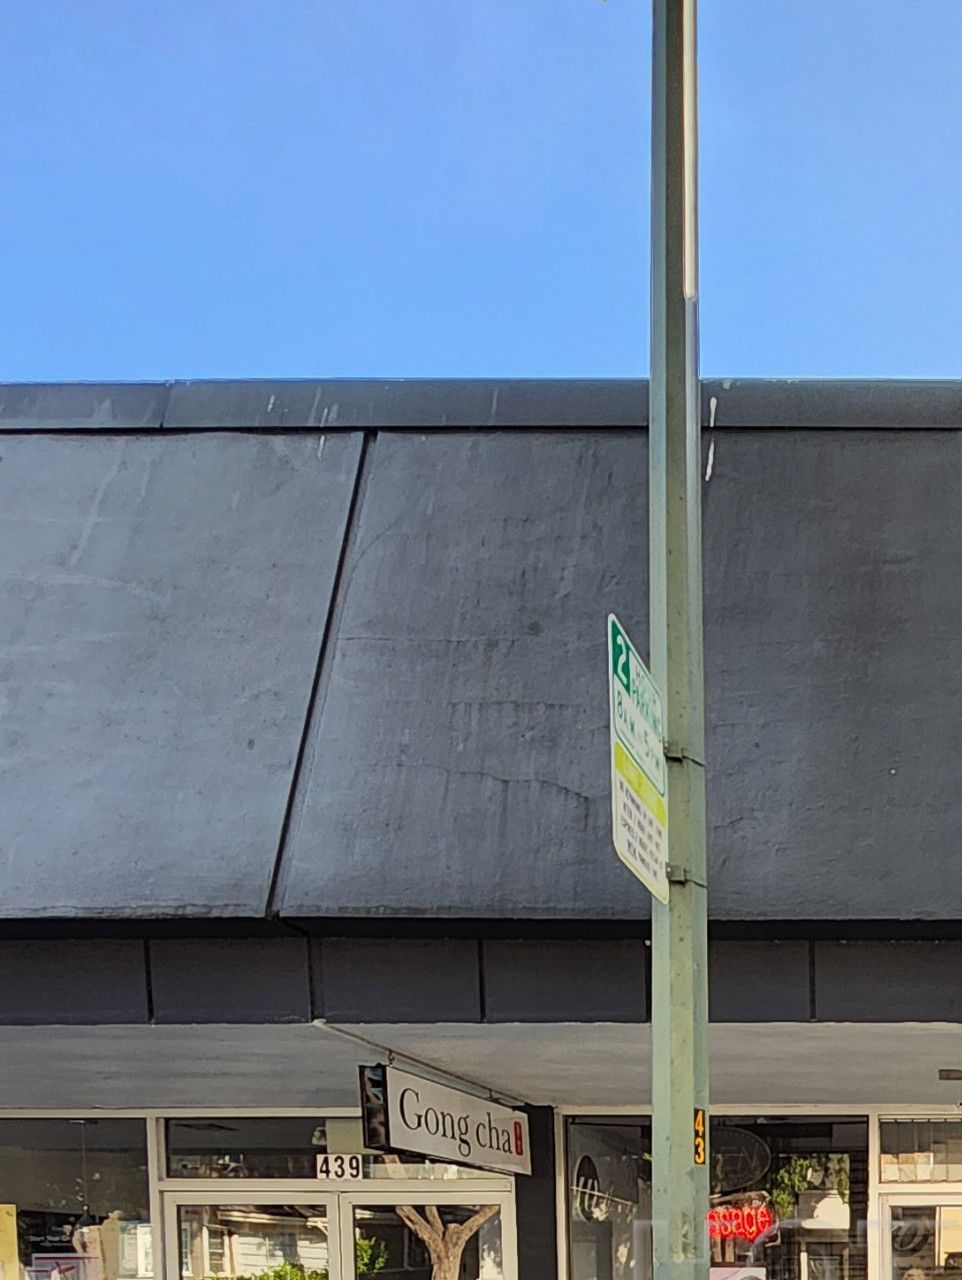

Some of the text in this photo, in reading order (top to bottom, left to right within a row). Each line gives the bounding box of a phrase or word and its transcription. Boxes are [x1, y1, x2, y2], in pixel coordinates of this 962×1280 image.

[616, 634, 629, 686] 2
[399, 1087, 472, 1157] Gong
[475, 1111, 513, 1155] cha
[319, 1155, 361, 1178] 439
